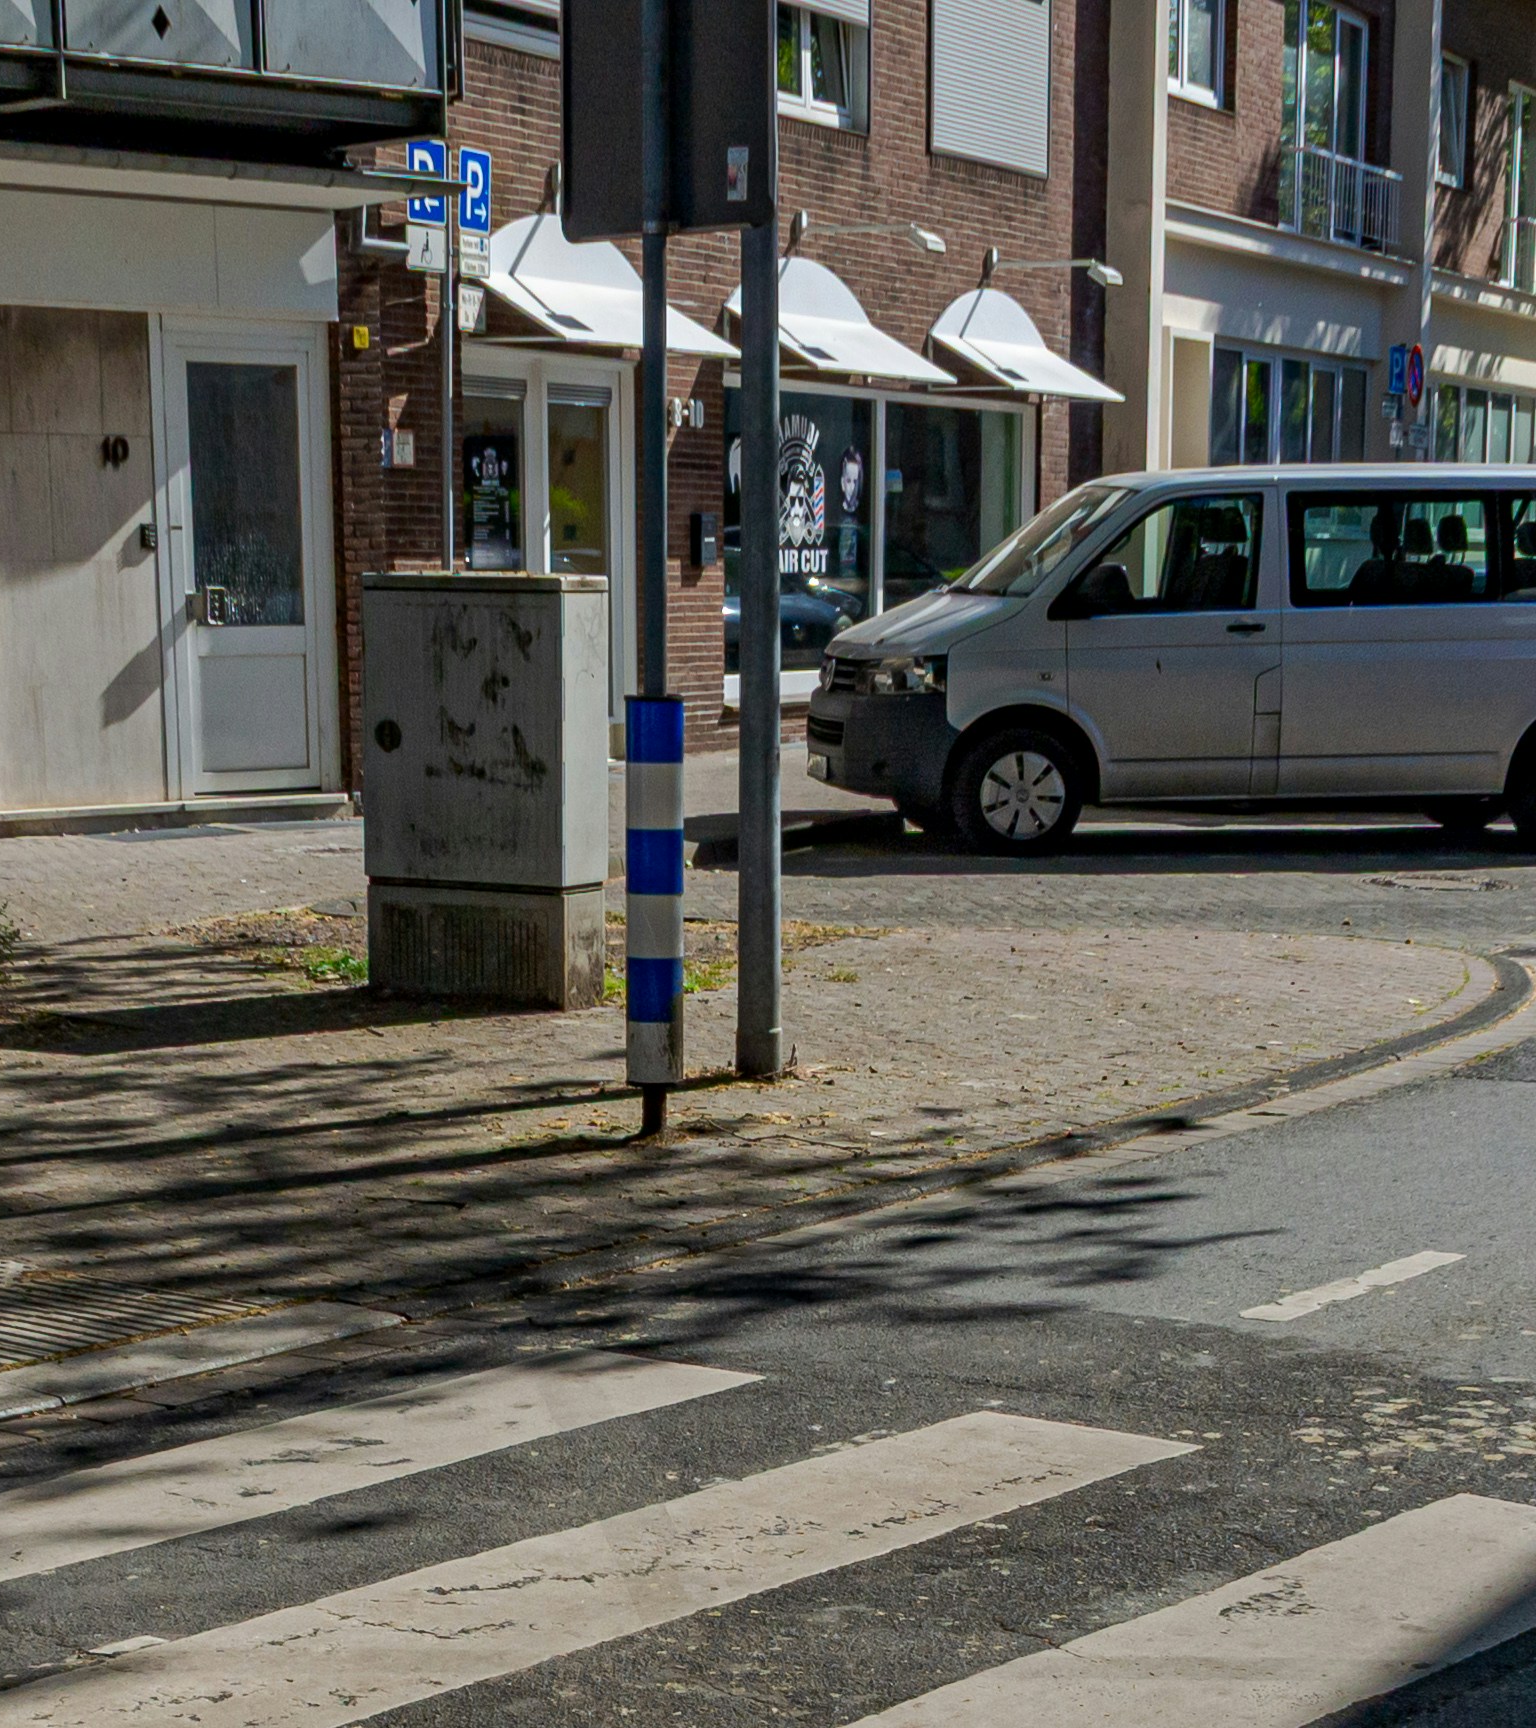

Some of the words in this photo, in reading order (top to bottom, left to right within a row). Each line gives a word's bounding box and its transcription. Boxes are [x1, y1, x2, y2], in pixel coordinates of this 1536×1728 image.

[414, 149, 435, 211] P
[467, 160, 484, 220] P
[101, 435, 129, 463] 10
[778, 548, 799, 574] AIR
[801, 548, 829, 574] CUT
